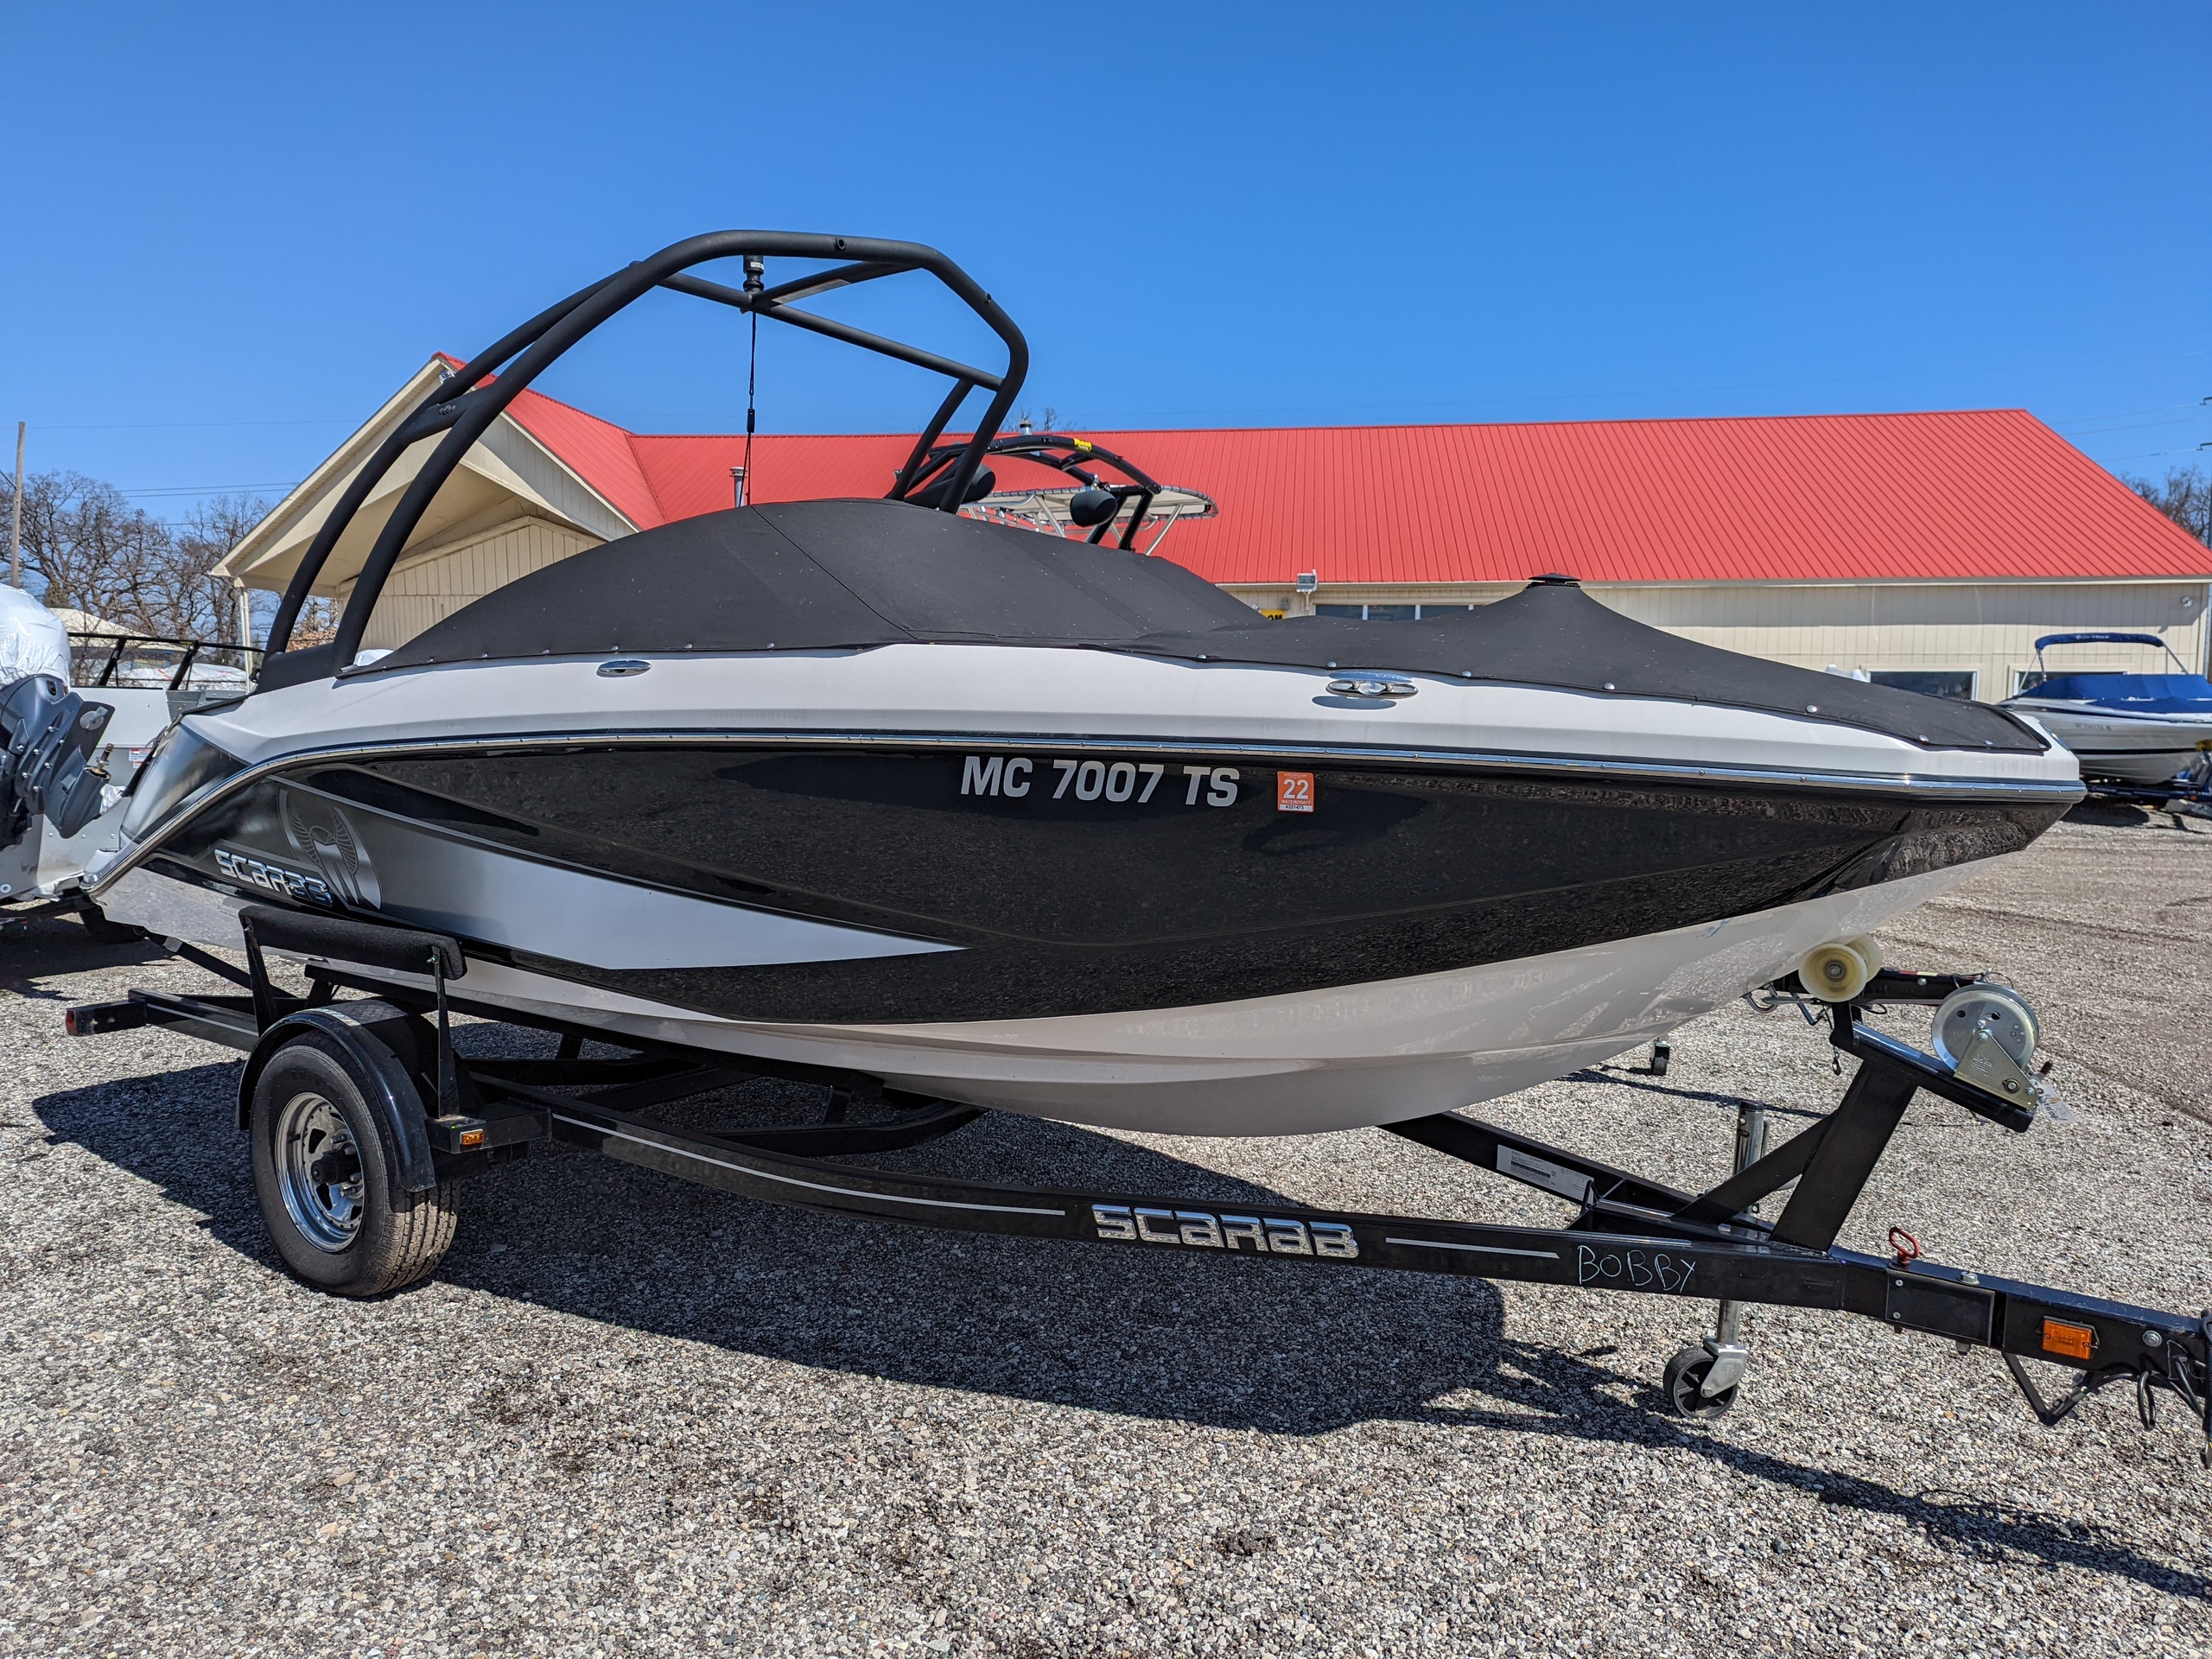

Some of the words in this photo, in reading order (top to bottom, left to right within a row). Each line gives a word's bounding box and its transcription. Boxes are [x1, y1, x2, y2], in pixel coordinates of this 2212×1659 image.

[960, 755, 1033, 798] MC
[1052, 759, 1164, 804] 7007
[1183, 765, 1241, 807] TS
[1283, 779, 1309, 799] 22
[1577, 1244, 1696, 1294] BOBBY
